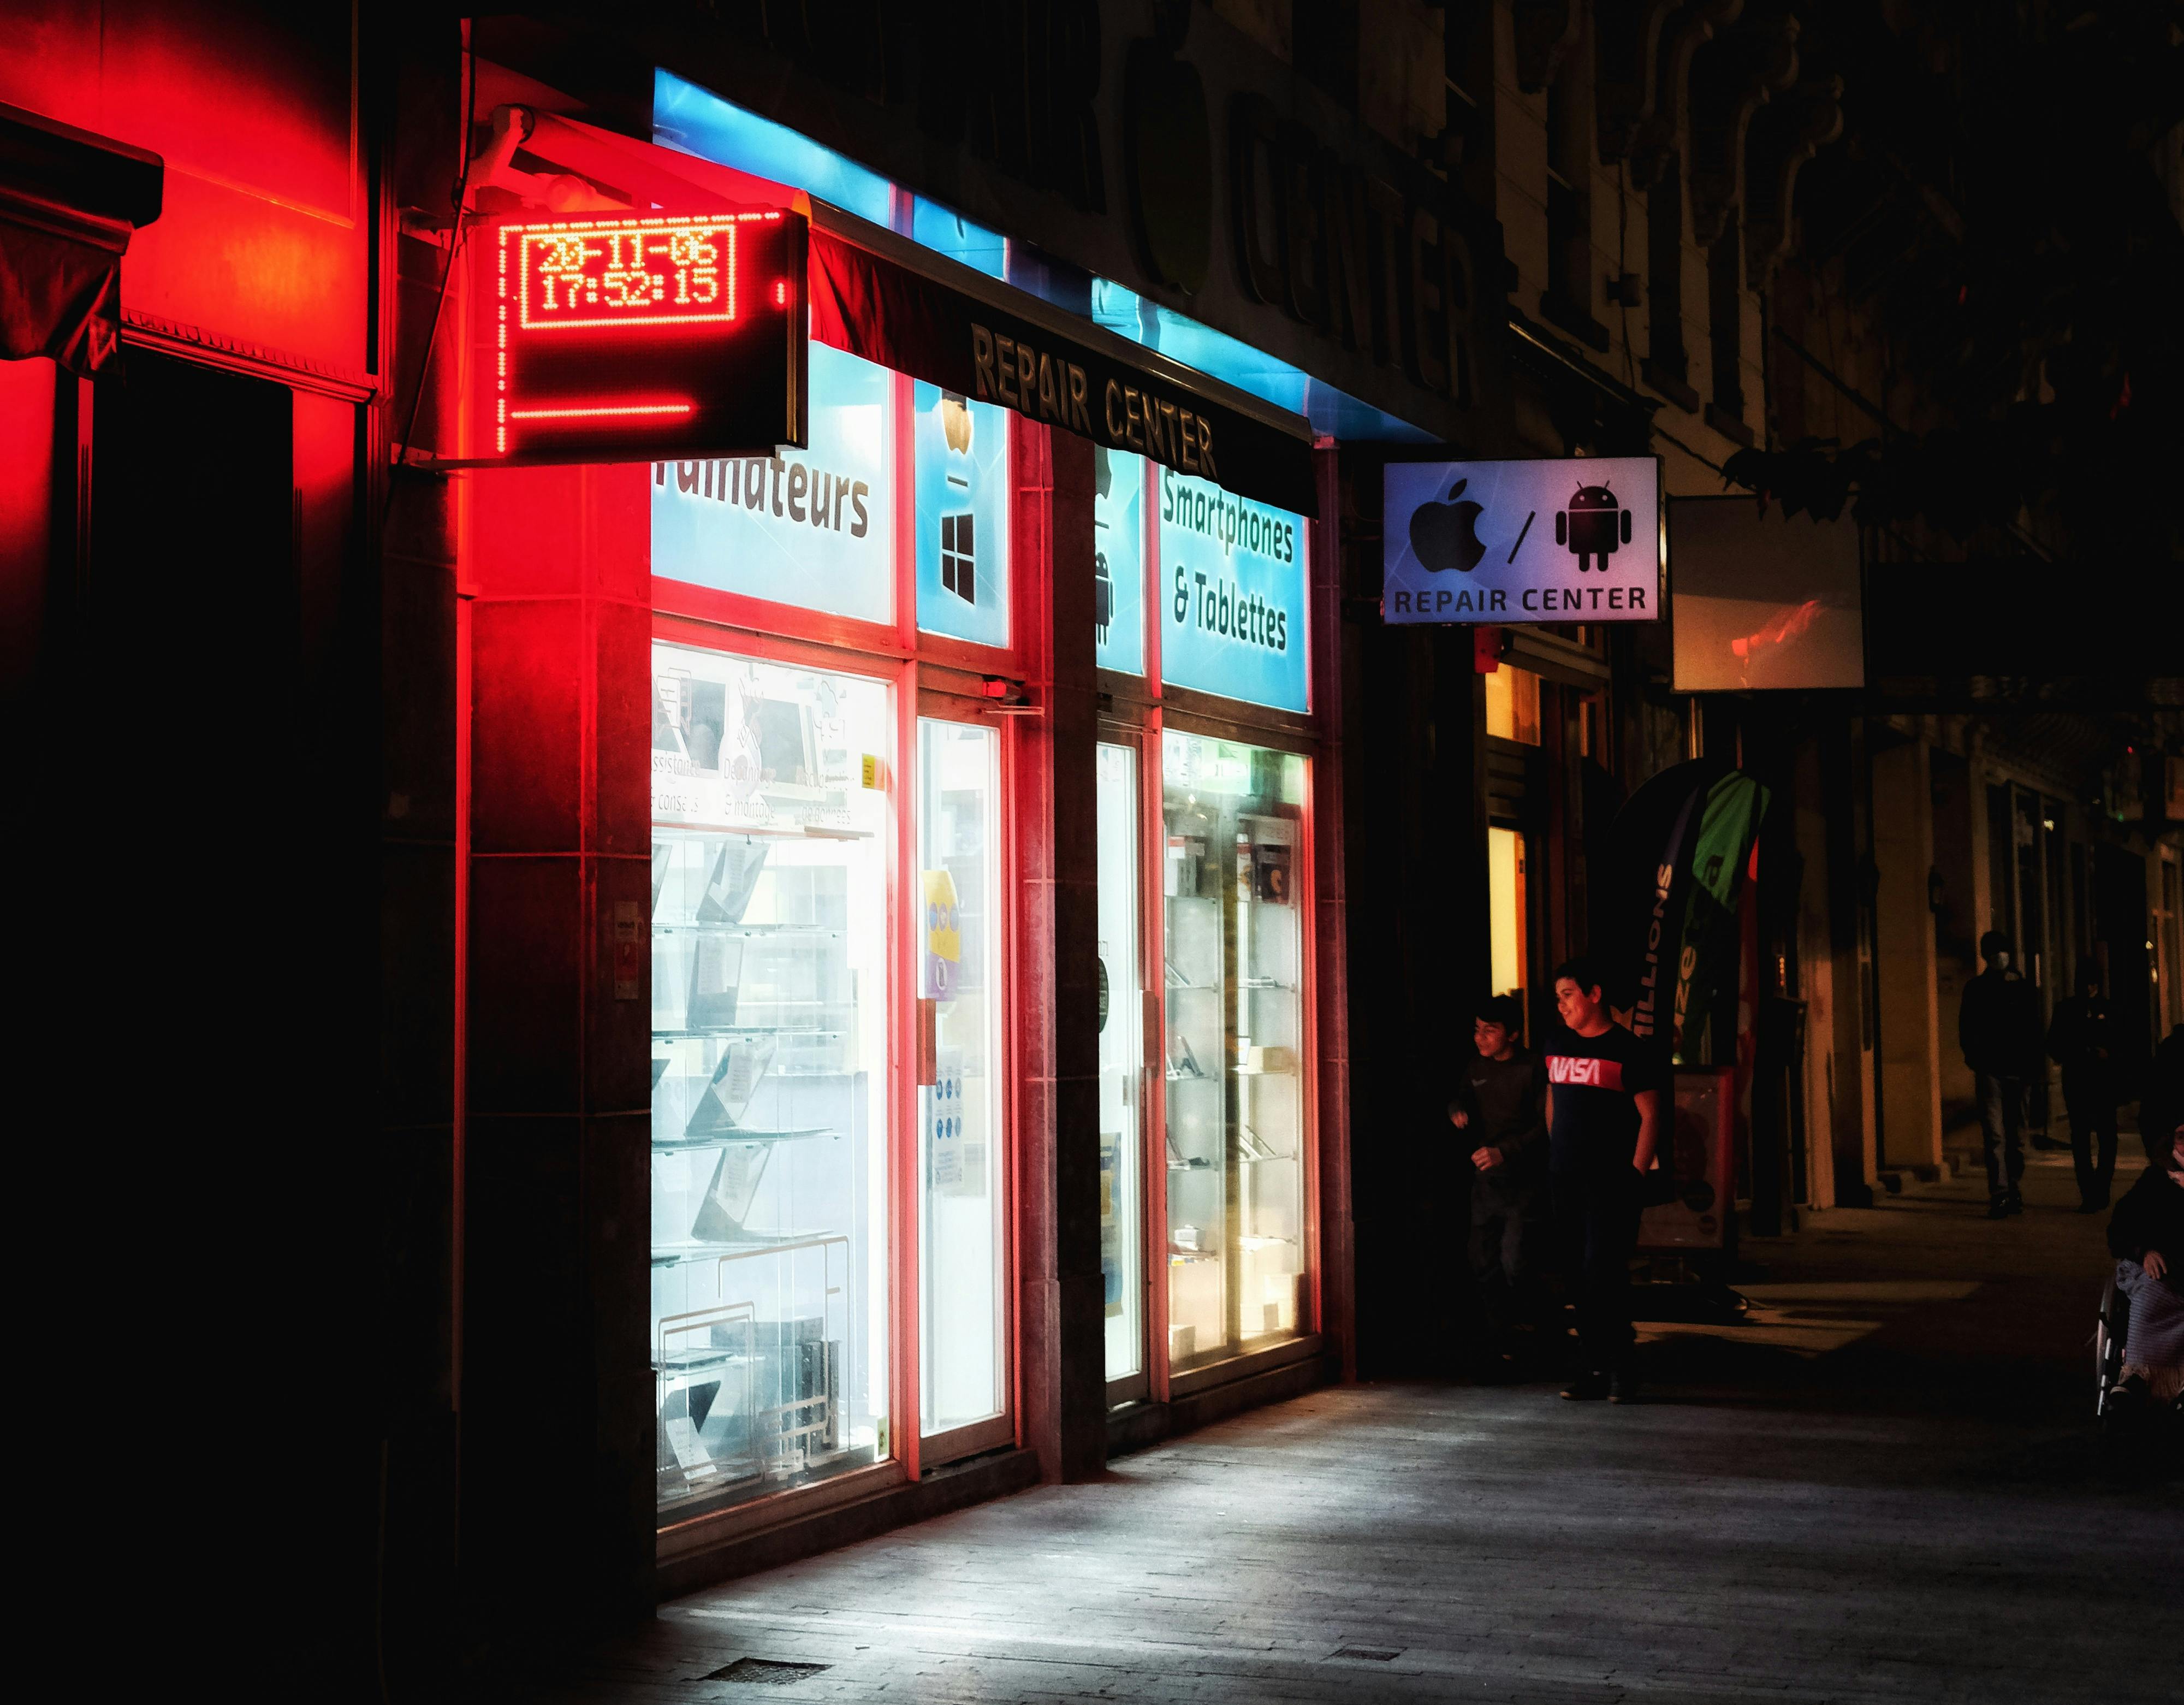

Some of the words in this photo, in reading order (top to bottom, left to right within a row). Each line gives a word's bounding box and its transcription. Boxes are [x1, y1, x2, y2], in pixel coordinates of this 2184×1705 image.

[542, 266, 719, 310] 17:52:15
[971, 322, 1092, 435] REPAIR
[1106, 378, 1218, 479] CENTER
[1163, 467, 1293, 563] Smartphones
[1174, 565, 1189, 623] &
[1195, 571, 1286, 651] Tablettes
[1394, 589, 1508, 613] REPAIR
[1522, 587, 1646, 611] CENTER
[1548, 1056, 1600, 1085] NASA
